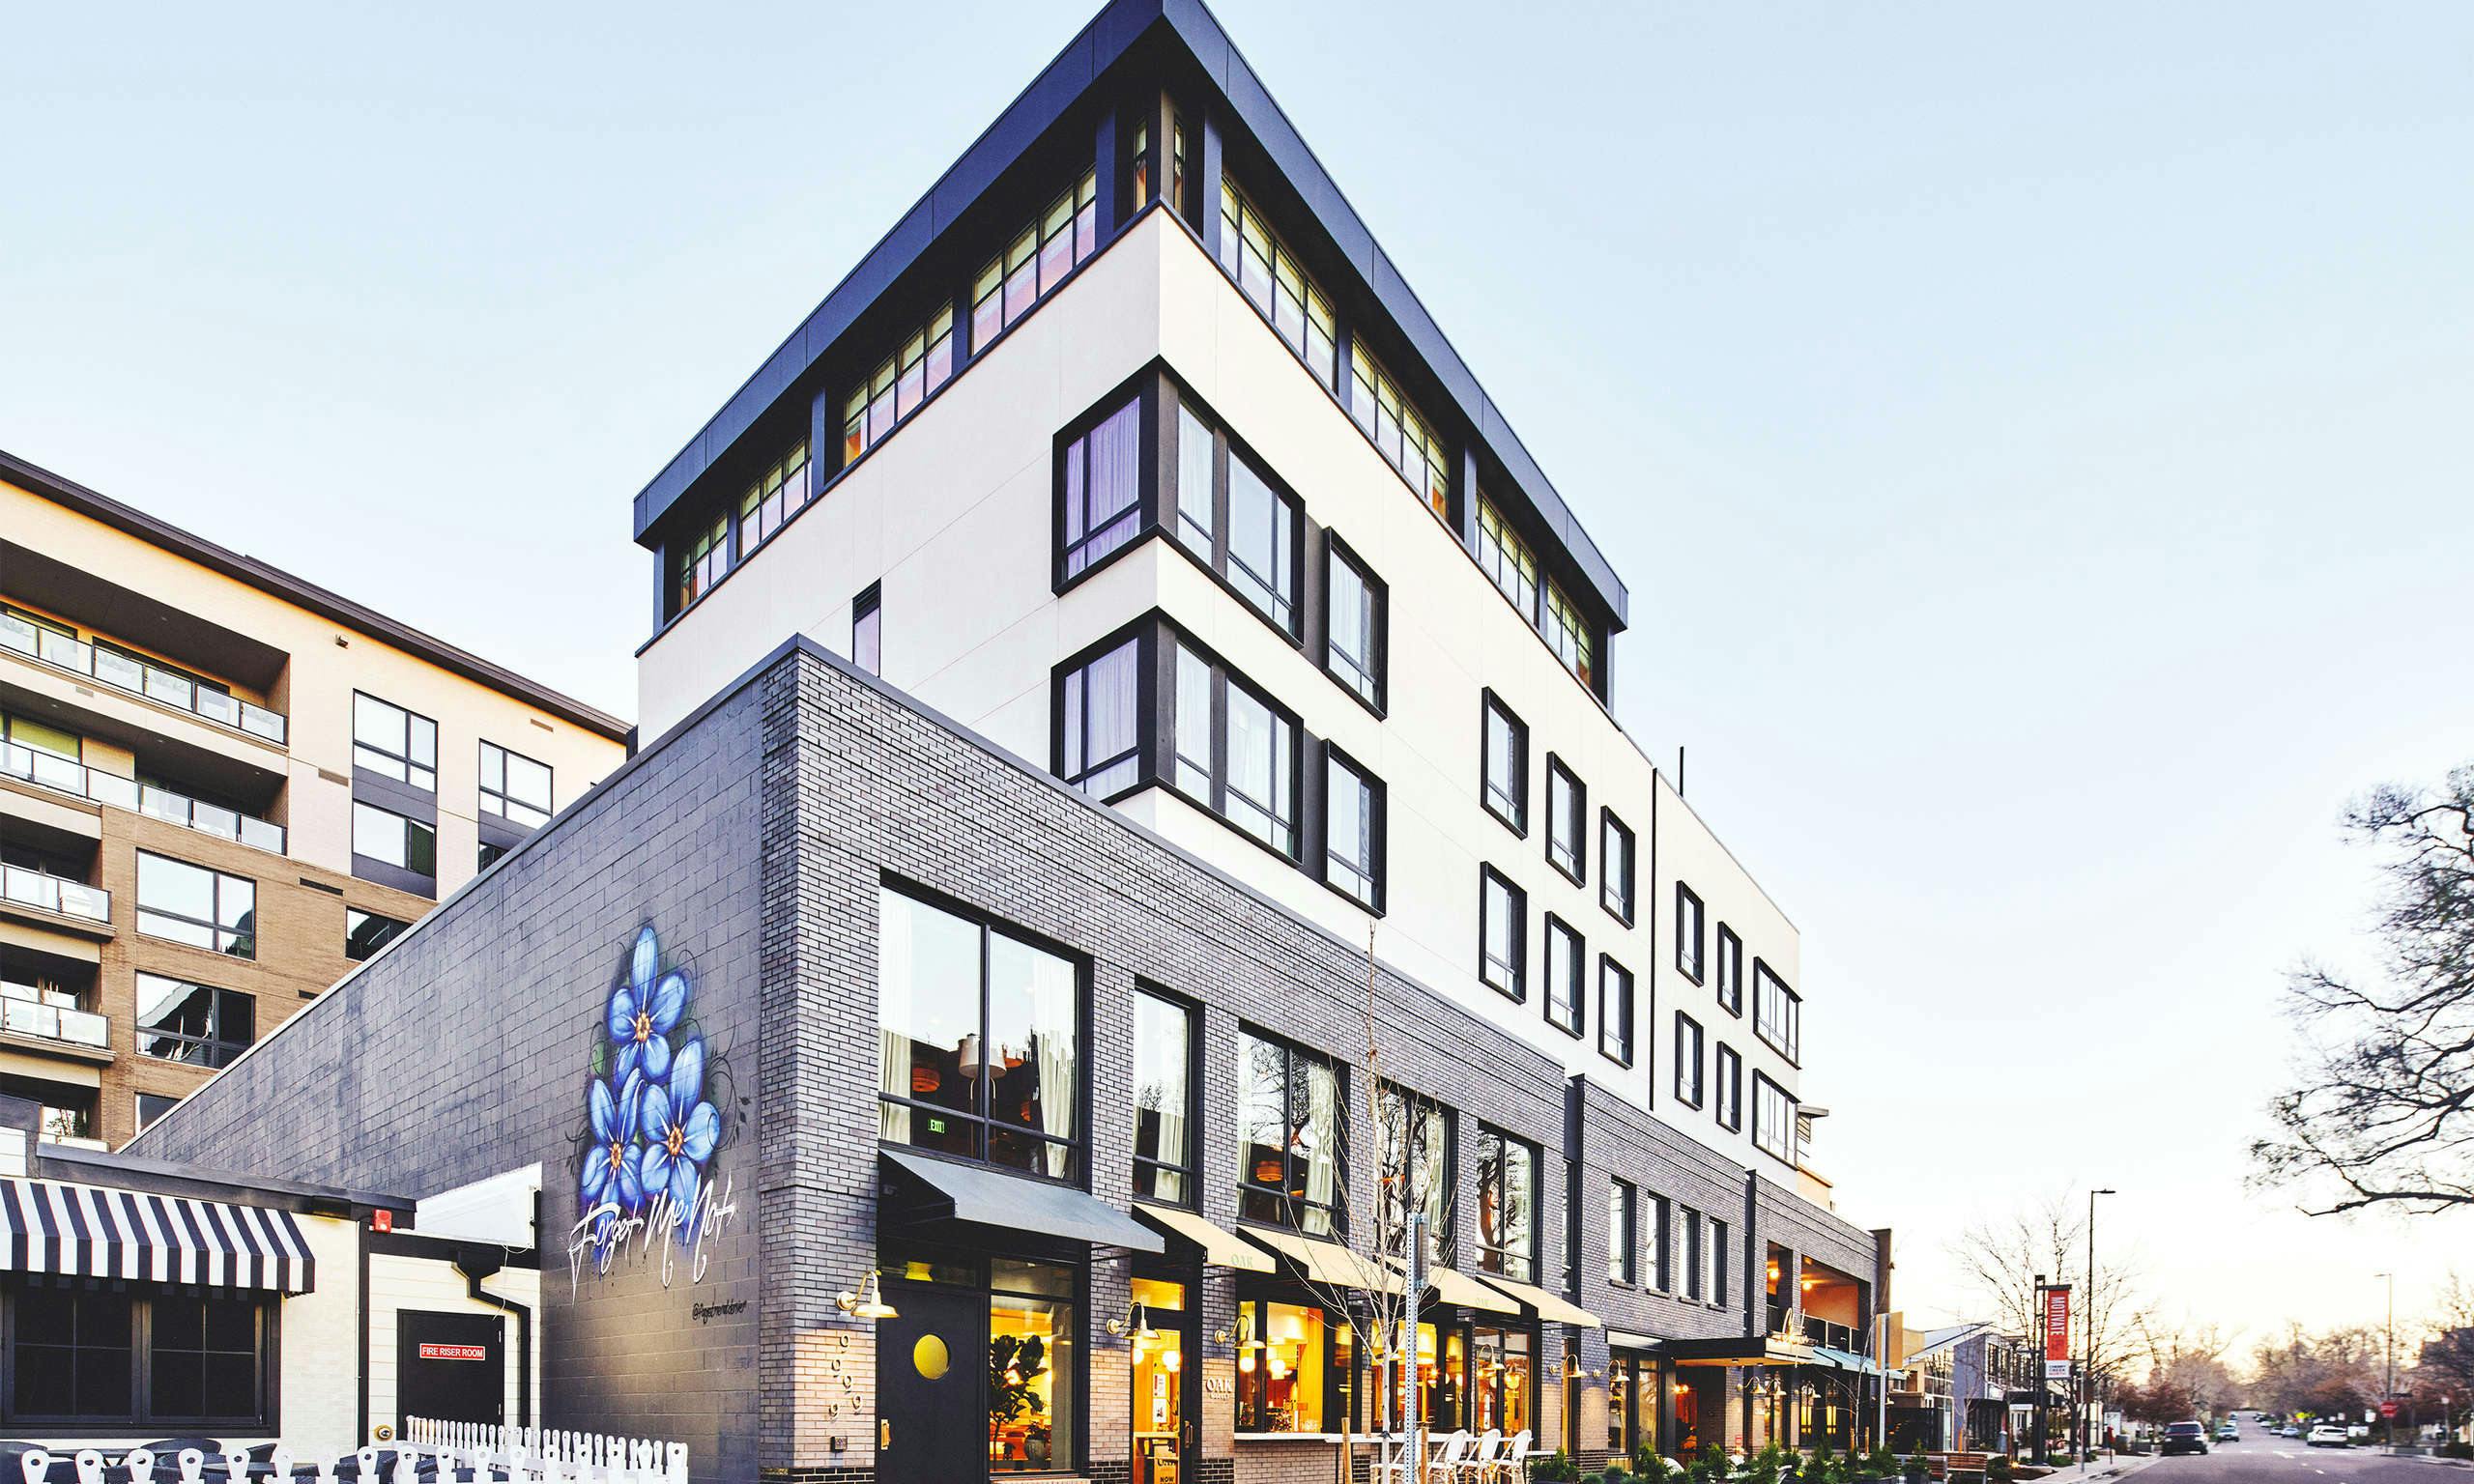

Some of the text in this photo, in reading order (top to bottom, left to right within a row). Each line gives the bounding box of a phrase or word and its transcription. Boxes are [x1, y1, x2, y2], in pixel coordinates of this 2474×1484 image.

[930, 1119, 945, 1133] EXIT
[567, 1168, 736, 1307] Forget Me Not
[1230, 1253, 1253, 1268] OAK
[2051, 1297, 2065, 1335] MOTIVATE
[422, 1347, 483, 1357] FIRE RISER ROOM
[1206, 1377, 1233, 1393] OAK
[829, 1403, 840, 1422] 9
